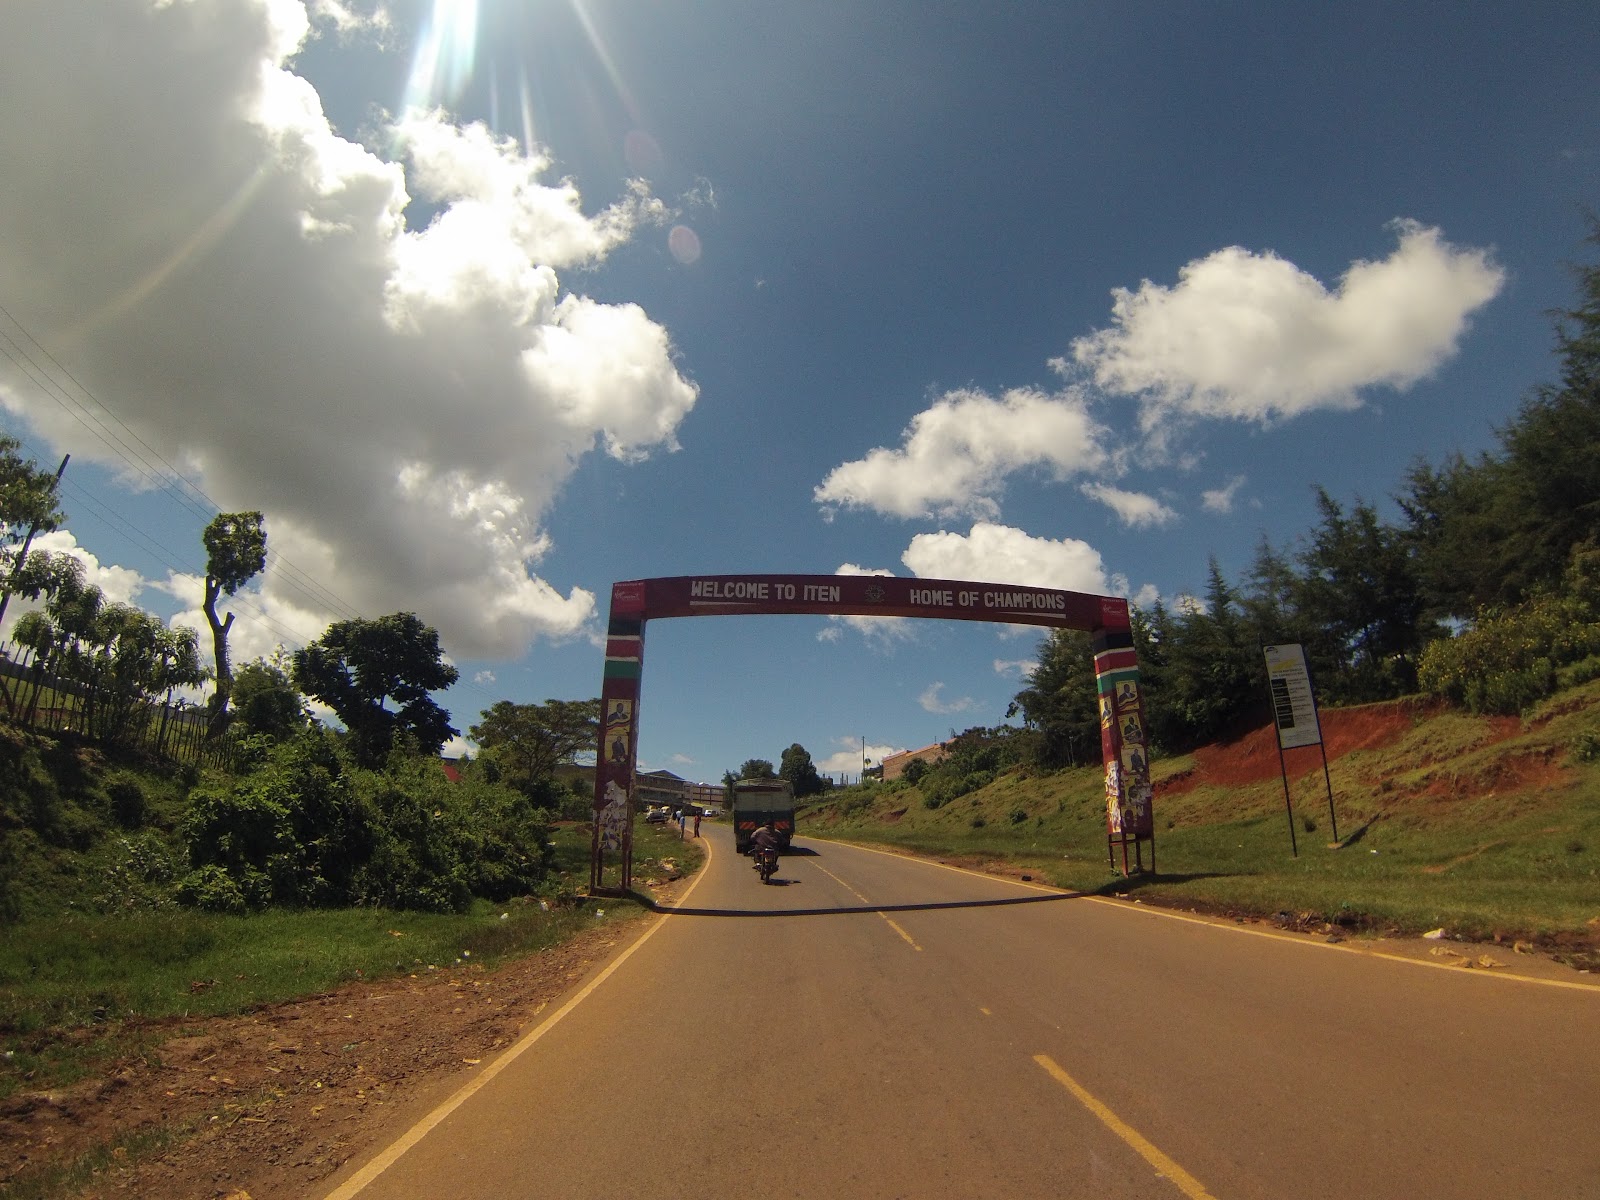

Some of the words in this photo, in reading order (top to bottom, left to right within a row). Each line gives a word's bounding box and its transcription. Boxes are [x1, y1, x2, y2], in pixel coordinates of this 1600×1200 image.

[690, 581, 768, 599] WELCOME
[774, 583, 796, 600] TO
[803, 585, 840, 602] ITEN
[910, 589, 953, 606] HOME
[959, 591, 979, 607] OF
[984, 592, 1066, 610] CHAMPIONS
